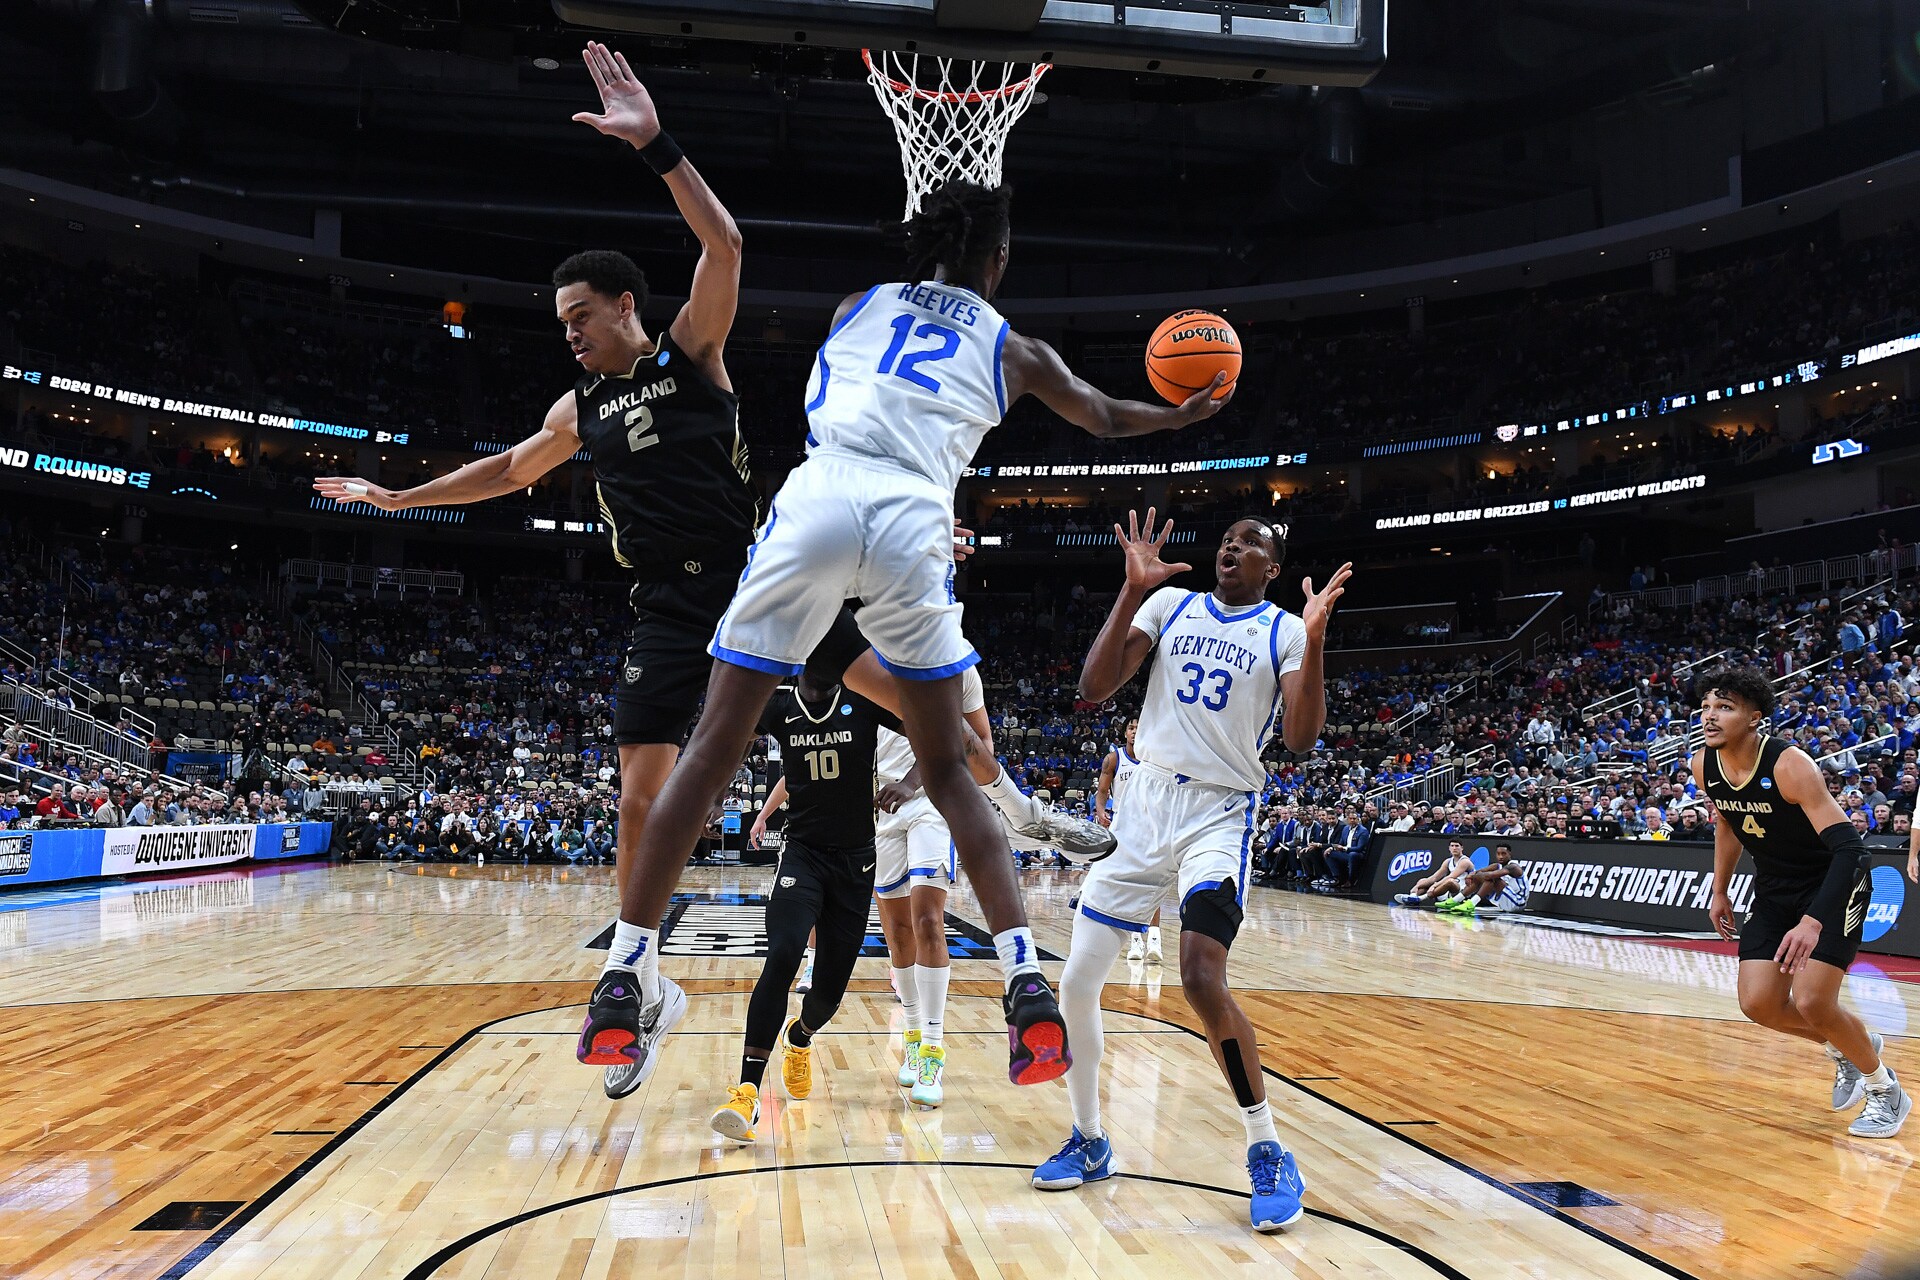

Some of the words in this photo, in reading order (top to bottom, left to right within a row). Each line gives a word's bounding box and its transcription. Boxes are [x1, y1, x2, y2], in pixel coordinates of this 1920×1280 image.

[329, 275, 351, 287] 226
[898, 284, 980, 327] REEVES
[1171, 327, 1235, 346] Wilson
[877, 313, 961, 394] 12
[1758, 380, 1764, 390] 0
[1785, 373, 1791, 383] 2
[599, 376, 677, 421] OAKLAND
[1691, 395, 1696, 404] 1
[1726, 387, 1732, 397] 0
[50, 375, 91, 394] 2024
[94, 385, 113, 399] DI
[115, 389, 161, 409] MEN'S
[163, 399, 256, 424] BASKETBALL
[258, 413, 369, 440] CHAMPIONSHIP
[1602, 413, 1608, 422] 0
[1630, 407, 1636, 416] 0
[624, 405, 660, 452] 2
[1542, 425, 1547, 434] 1
[1574, 419, 1580, 427] 2
[34, 454, 127, 485] ROUNDS
[998, 466, 1031, 476] 2024
[1034, 466, 1049, 476] DI
[1051, 465, 1089, 476] MEN'S
[1091, 463, 1168, 476] BASKETBALL
[1171, 456, 1270, 473] CHAMPIONSHIP
[1376, 514, 1430, 529] OAKLAND
[1433, 509, 1482, 524] GOLDEN
[1483, 500, 1550, 519] GRIZZLIES
[1554, 499, 1567, 509] VS
[1570, 486, 1636, 507] KENTUCKY
[1637, 475, 1706, 497] WILDCATS
[586, 522, 593, 532] 0
[969, 536, 975, 545] 0
[1170, 635, 1258, 675] KENTUCKY
[1176, 662, 1233, 712] 33
[789, 730, 852, 747] OAKLAND
[804, 749, 840, 780] 10
[1715, 798, 1773, 813] OAKLAND
[1741, 815, 1766, 838] 4
[110, 844, 130, 856] HOSTED
[134, 832, 198, 865] DUQUESNE
[199, 829, 252, 858] UNIVERSITY
[1390, 850, 1433, 877] OREO
[1865, 903, 1900, 924] CAA
